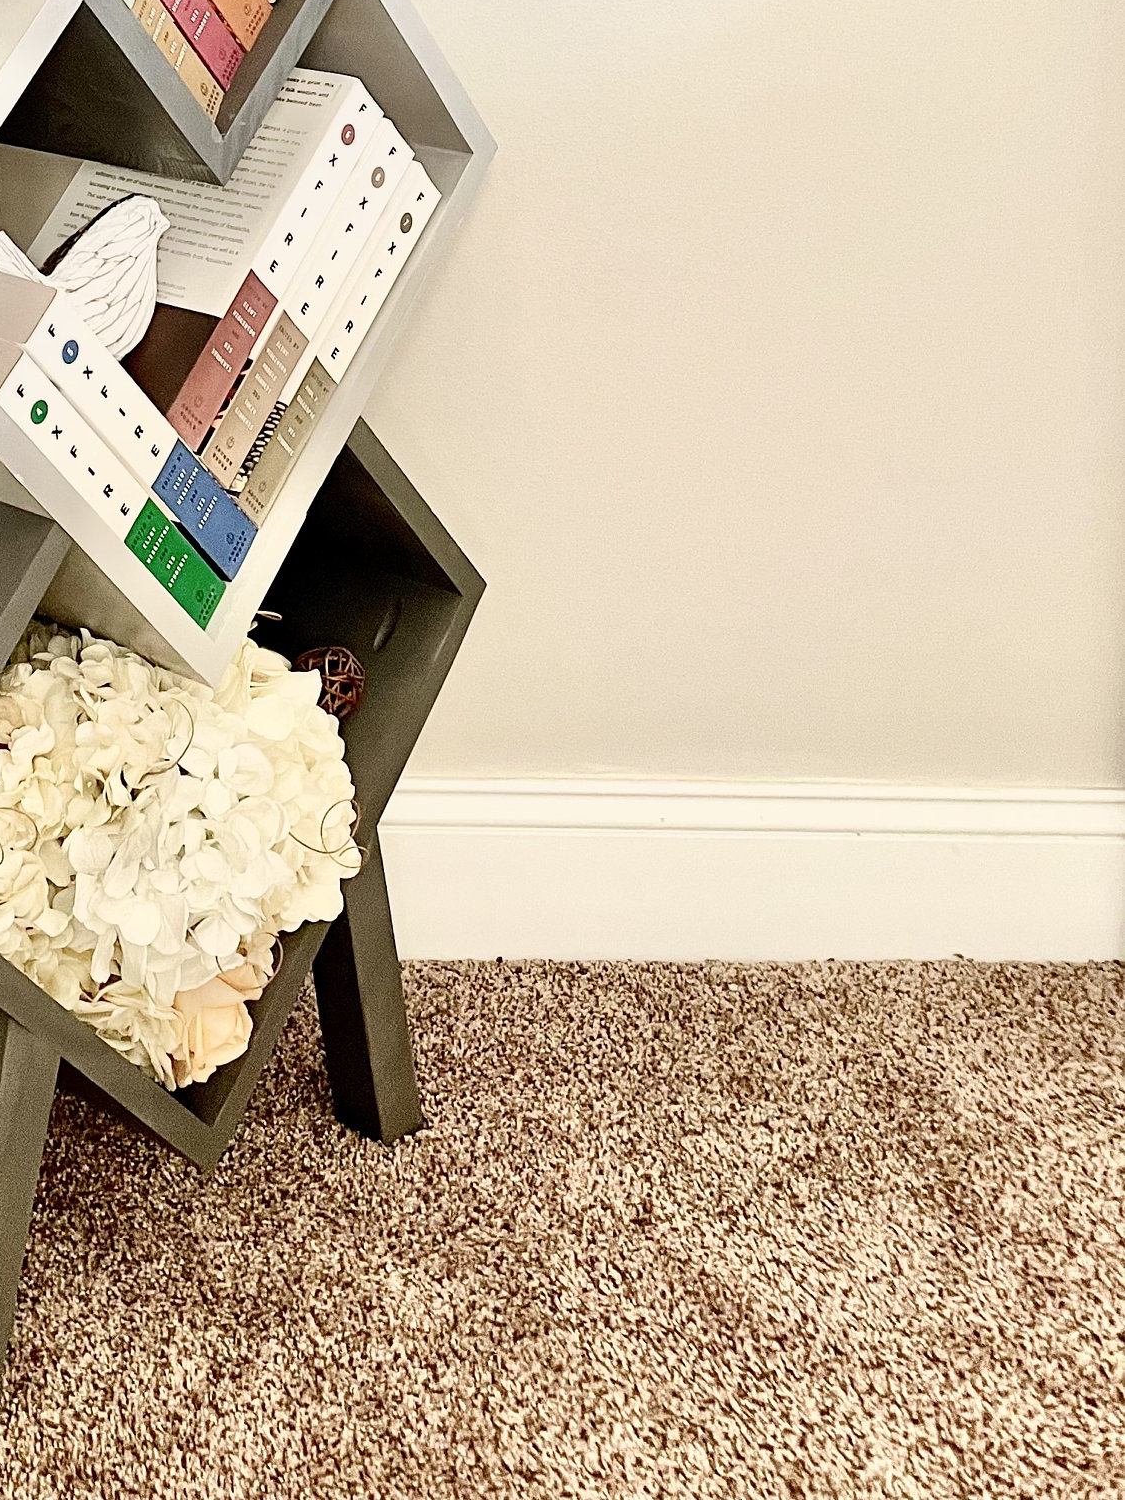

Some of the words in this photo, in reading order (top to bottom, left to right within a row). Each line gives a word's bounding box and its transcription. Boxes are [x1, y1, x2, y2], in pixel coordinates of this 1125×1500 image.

[223, 340, 233, 354] HIS
[210, 346, 232, 374] STUDENTS
[172, 467, 186, 491] ELIOT
[142, 525, 156, 550] ELIOT
